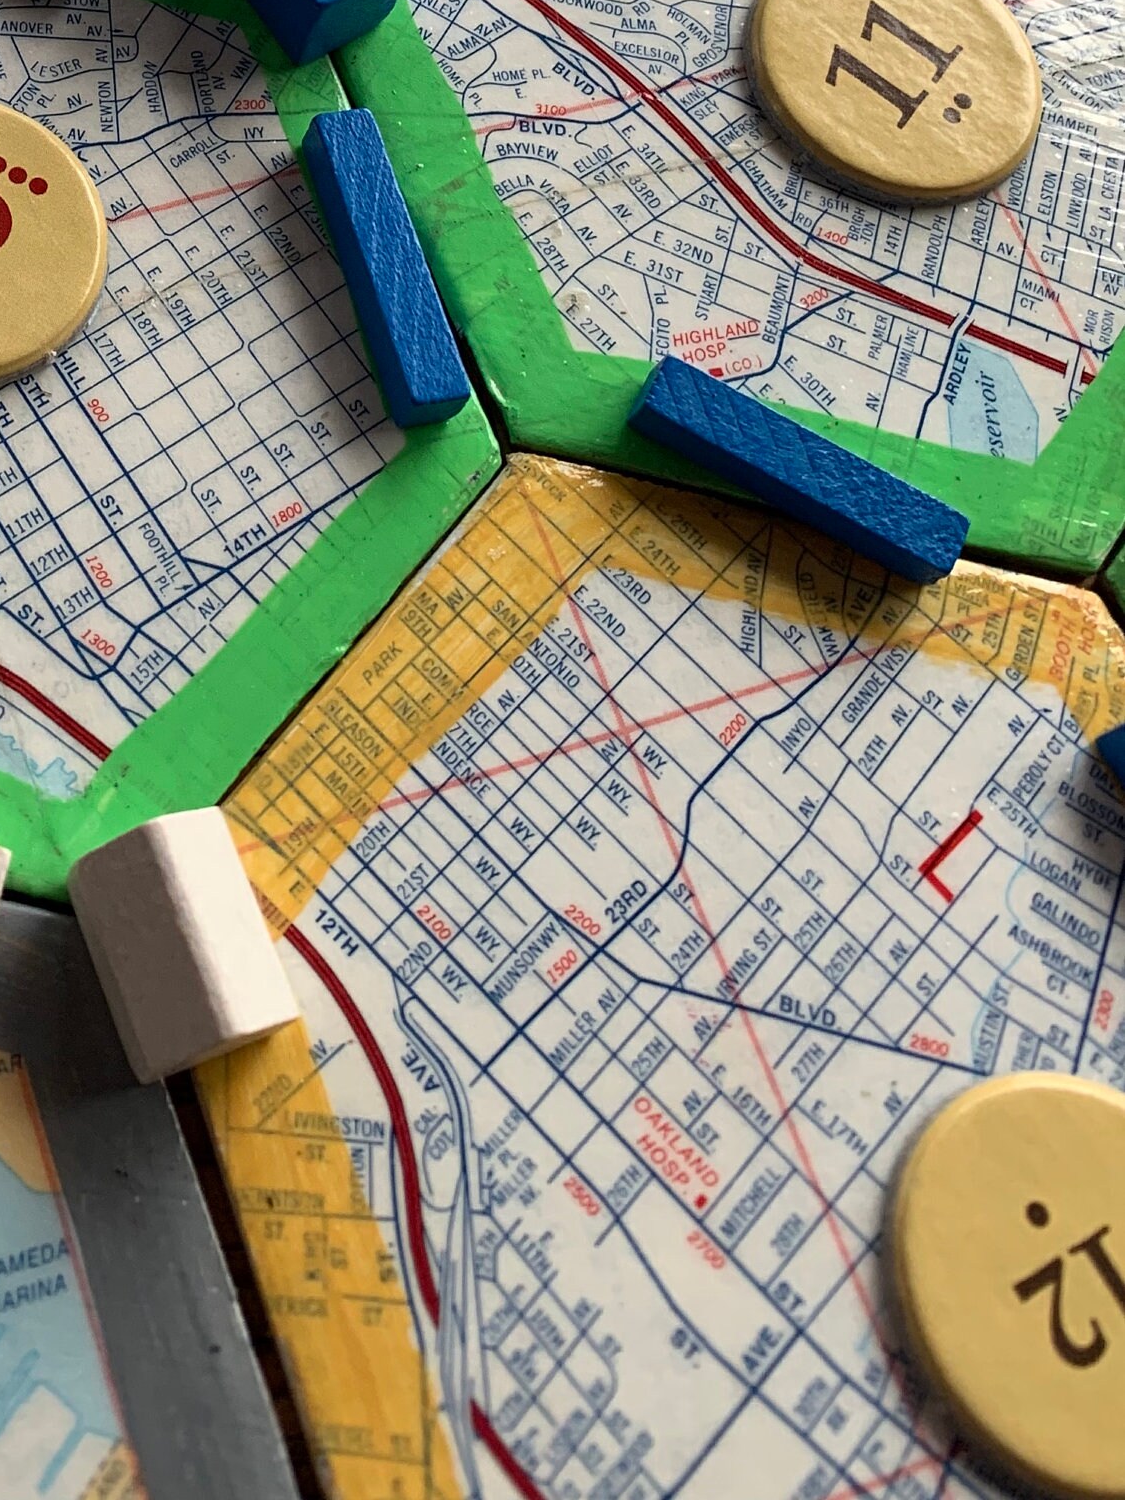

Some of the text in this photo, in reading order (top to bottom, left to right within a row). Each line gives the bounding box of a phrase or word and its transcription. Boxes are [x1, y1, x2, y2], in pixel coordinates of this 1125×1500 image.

[666, 5, 711, 46] HOLMAN
[693, 5, 729, 69] GROSVENOR
[30, 58, 82, 80] LESTER
[614, 41, 680, 65] EXCELSIOR
[825, 0, 963, 129] 11
[191, 50, 213, 112] PORTLAND
[492, 69, 527, 80] HOME
[100, 80, 113, 132] NEWTON
[234, 99, 266, 110] 2300
[535, 103, 566, 117] 3100
[169, 136, 218, 168] CARROLL
[495, 143, 559, 162] BAYVIEW
[574, 145, 615, 173] ELLIOT
[744, 158, 787, 210] CHATHAM
[923, 215, 947, 283] RANDOLPH
[762, 274, 791, 344] BEAUMONT
[672, 320, 760, 346] HIGHLAND
[868, 316, 888, 360] PALMER
[724, 356, 762, 374] (CO.)
[944, 344, 972, 406] ARDLEY
[272, 502, 303, 527] 1800
[138, 522, 184, 585] FOOTHILL
[224, 524, 267, 558] 14TH
[741, 572, 765, 653] HIGHLAND
[129, 651, 165, 686] 15TH
[841, 671, 886, 723] GRANDE
[719, 713, 748, 747] 2200
[782, 717, 813, 751] INYO
[605, 880, 648, 923] 23RD
[1030, 893, 1101, 946] GALINDO
[416, 905, 452, 941] 2100
[1008, 925, 1095, 986] ASHBROOK
[909, 1034, 950, 1057] 2800
[633, 1096, 720, 1188] OAKLAND
[720, 1167, 782, 1239] MITCHELL
